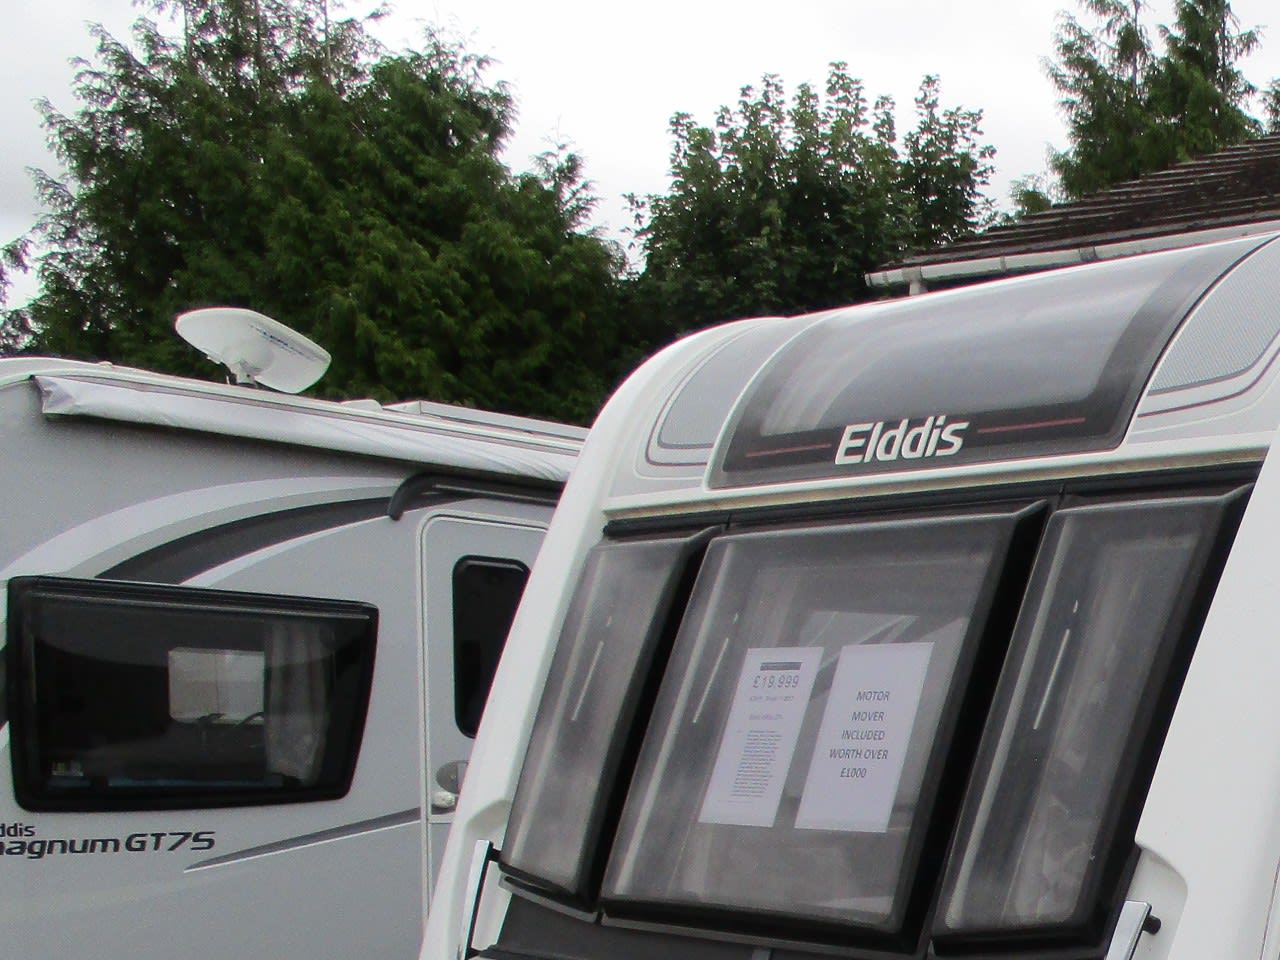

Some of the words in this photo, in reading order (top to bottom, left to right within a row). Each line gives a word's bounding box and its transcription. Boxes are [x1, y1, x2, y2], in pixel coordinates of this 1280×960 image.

[834, 415, 970, 465] Elddis
[856, 691, 890, 701] MOTOR
[851, 711, 884, 721] MOVER
[841, 730, 885, 741] INCLUDED
[829, 748, 862, 759] WORTH
[863, 749, 889, 760] OVER
[840, 767, 867, 778] £1000
[0, 838, 120, 859] agnum
